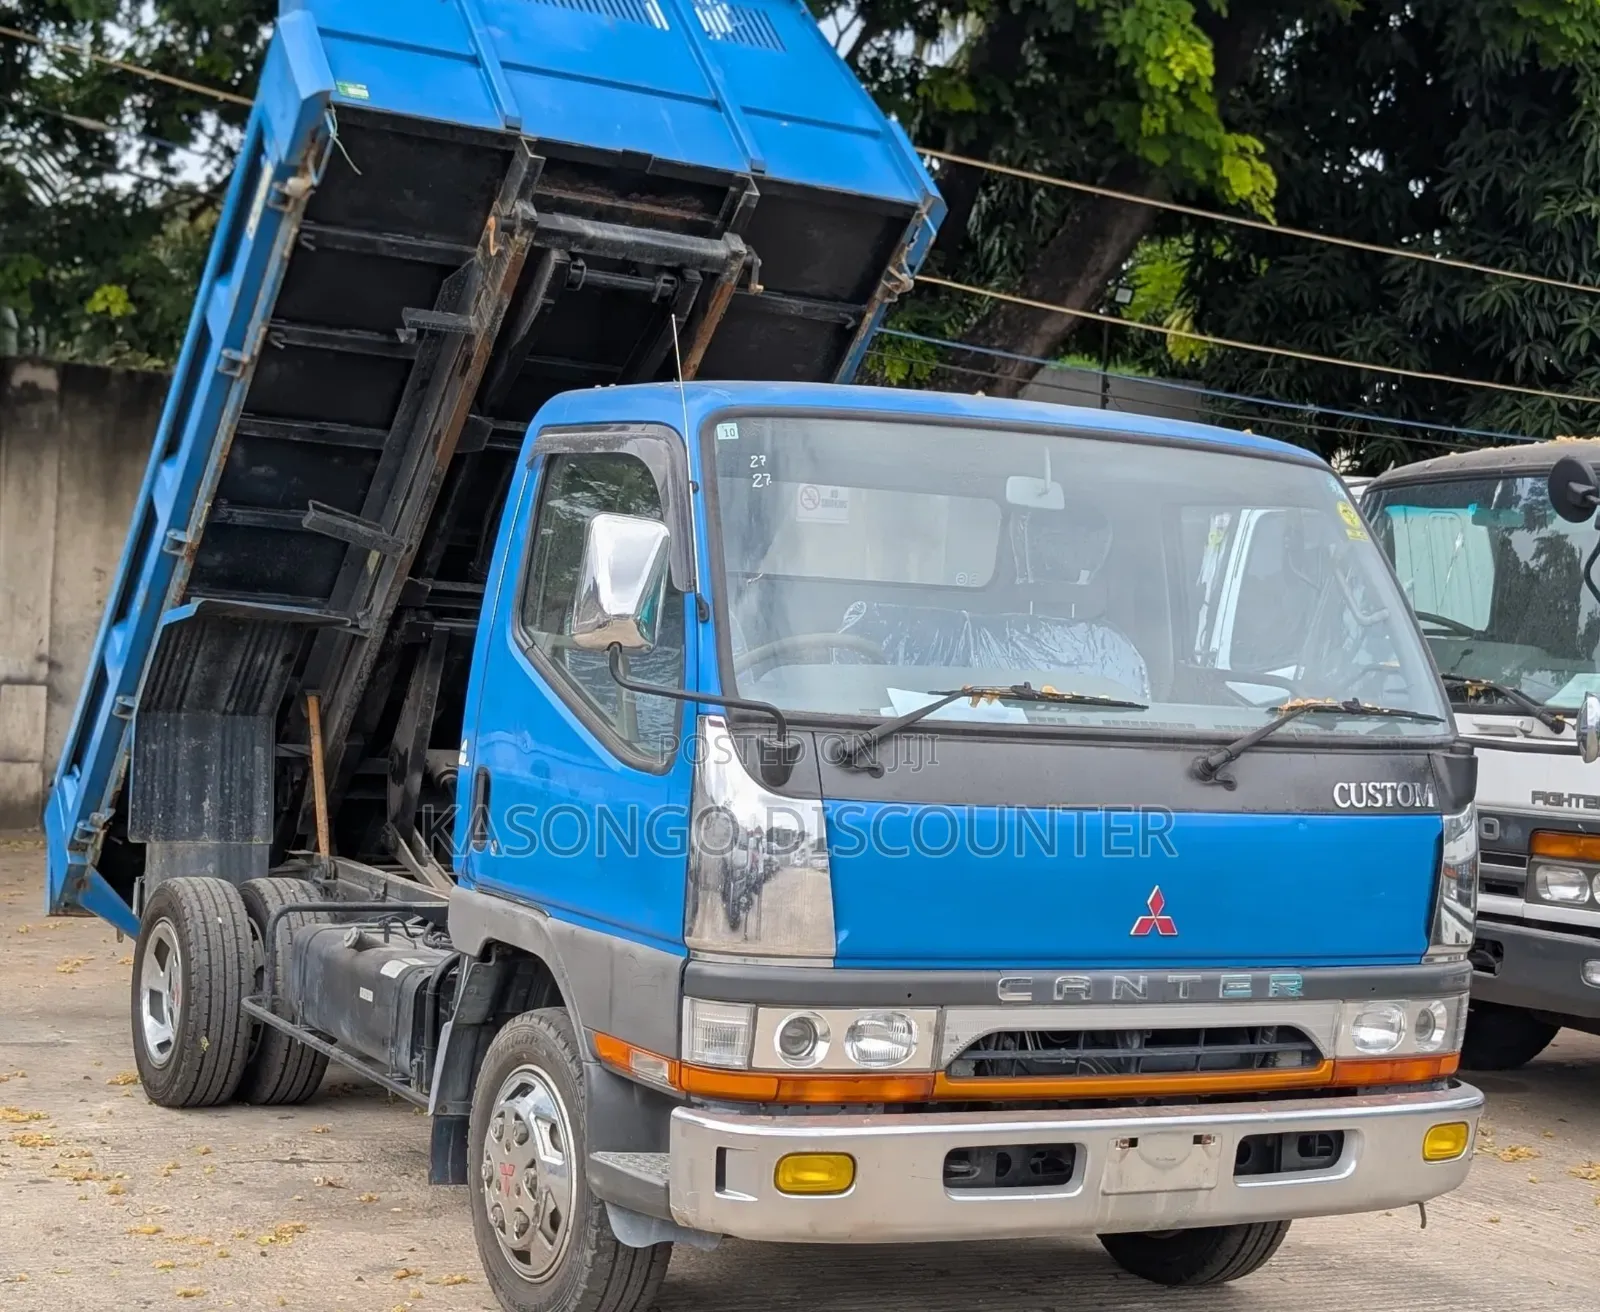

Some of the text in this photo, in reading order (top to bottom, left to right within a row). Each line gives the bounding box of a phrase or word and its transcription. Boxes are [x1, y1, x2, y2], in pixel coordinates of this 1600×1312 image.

[724, 428, 736, 438] 10
[750, 455, 766, 468] 27
[1333, 782, 1435, 808] CUSTOM
[1531, 790, 1600, 809] FIGHTE
[997, 974, 1304, 1001] CANTER
